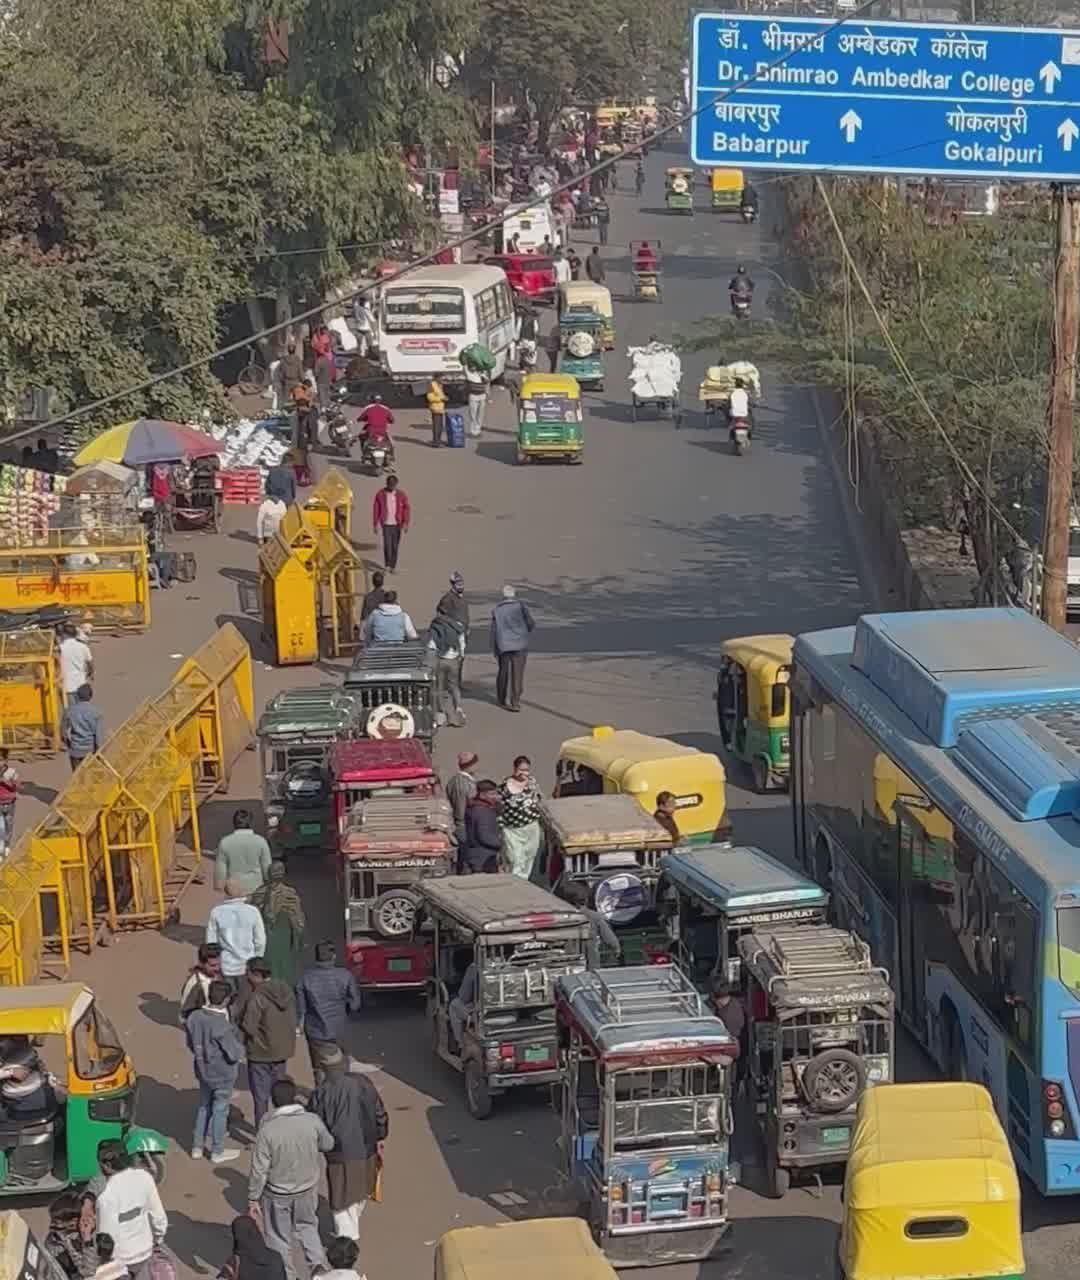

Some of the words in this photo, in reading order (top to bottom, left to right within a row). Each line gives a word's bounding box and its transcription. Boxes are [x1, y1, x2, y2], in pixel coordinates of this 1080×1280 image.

[717, 23, 748, 50] डॉ.
[761, 23, 825, 54] भीमराव
[838, 27, 918, 57] अम्बेडकर
[930, 31, 988, 61] कॉलेज
[718, 61, 749, 81] Dr.
[851, 66, 953, 90] Ambedkar
[961, 71, 1035, 94] College
[714, 102, 781, 132] बाबरपुर
[945, 105, 1028, 142] गोकलपुरी
[712, 134, 809, 159] Babarpur
[944, 142, 1043, 166] Gokalpuri
